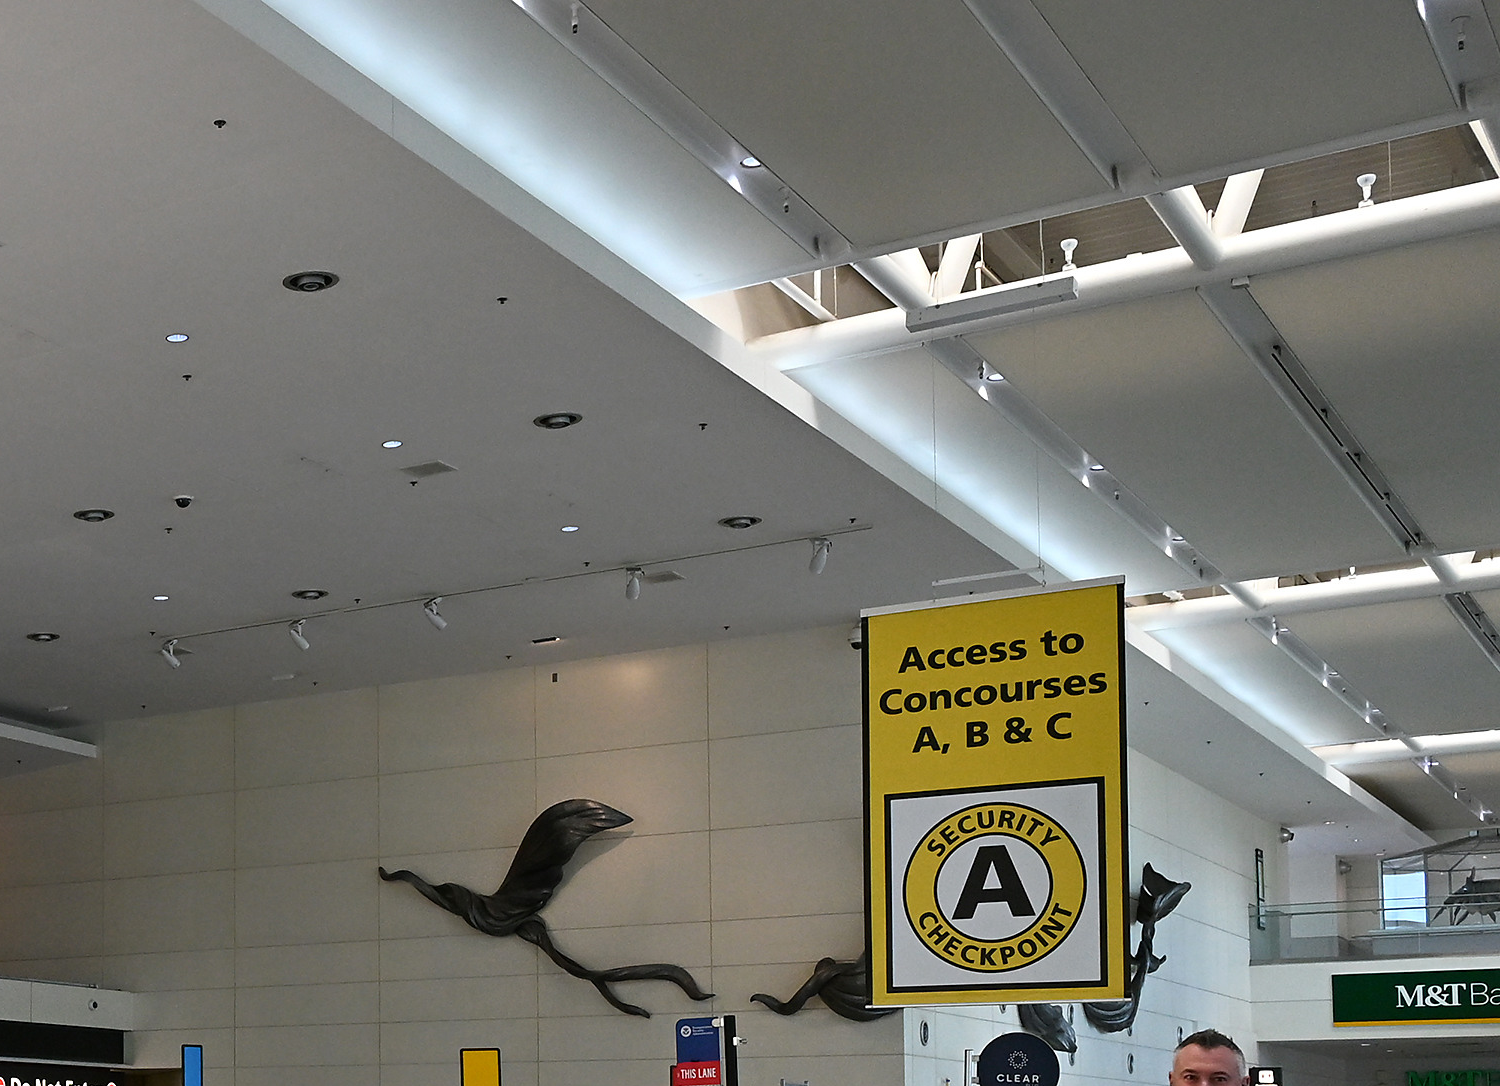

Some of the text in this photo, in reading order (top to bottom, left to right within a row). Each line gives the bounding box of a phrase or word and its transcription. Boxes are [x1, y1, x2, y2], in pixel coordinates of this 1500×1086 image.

[898, 630, 1085, 674] Access to
[879, 671, 1108, 715] Concourses
[912, 712, 1073, 754] A, B & C
[927, 809, 1061, 858] SECURITY
[951, 844, 1036, 921] A
[918, 902, 1074, 966] CHECKPOINT
[1395, 983, 1466, 1008] M&T
[681, 1067, 716, 1079] THIS LANE
[996, 1074, 1039, 1083] CLEAR
